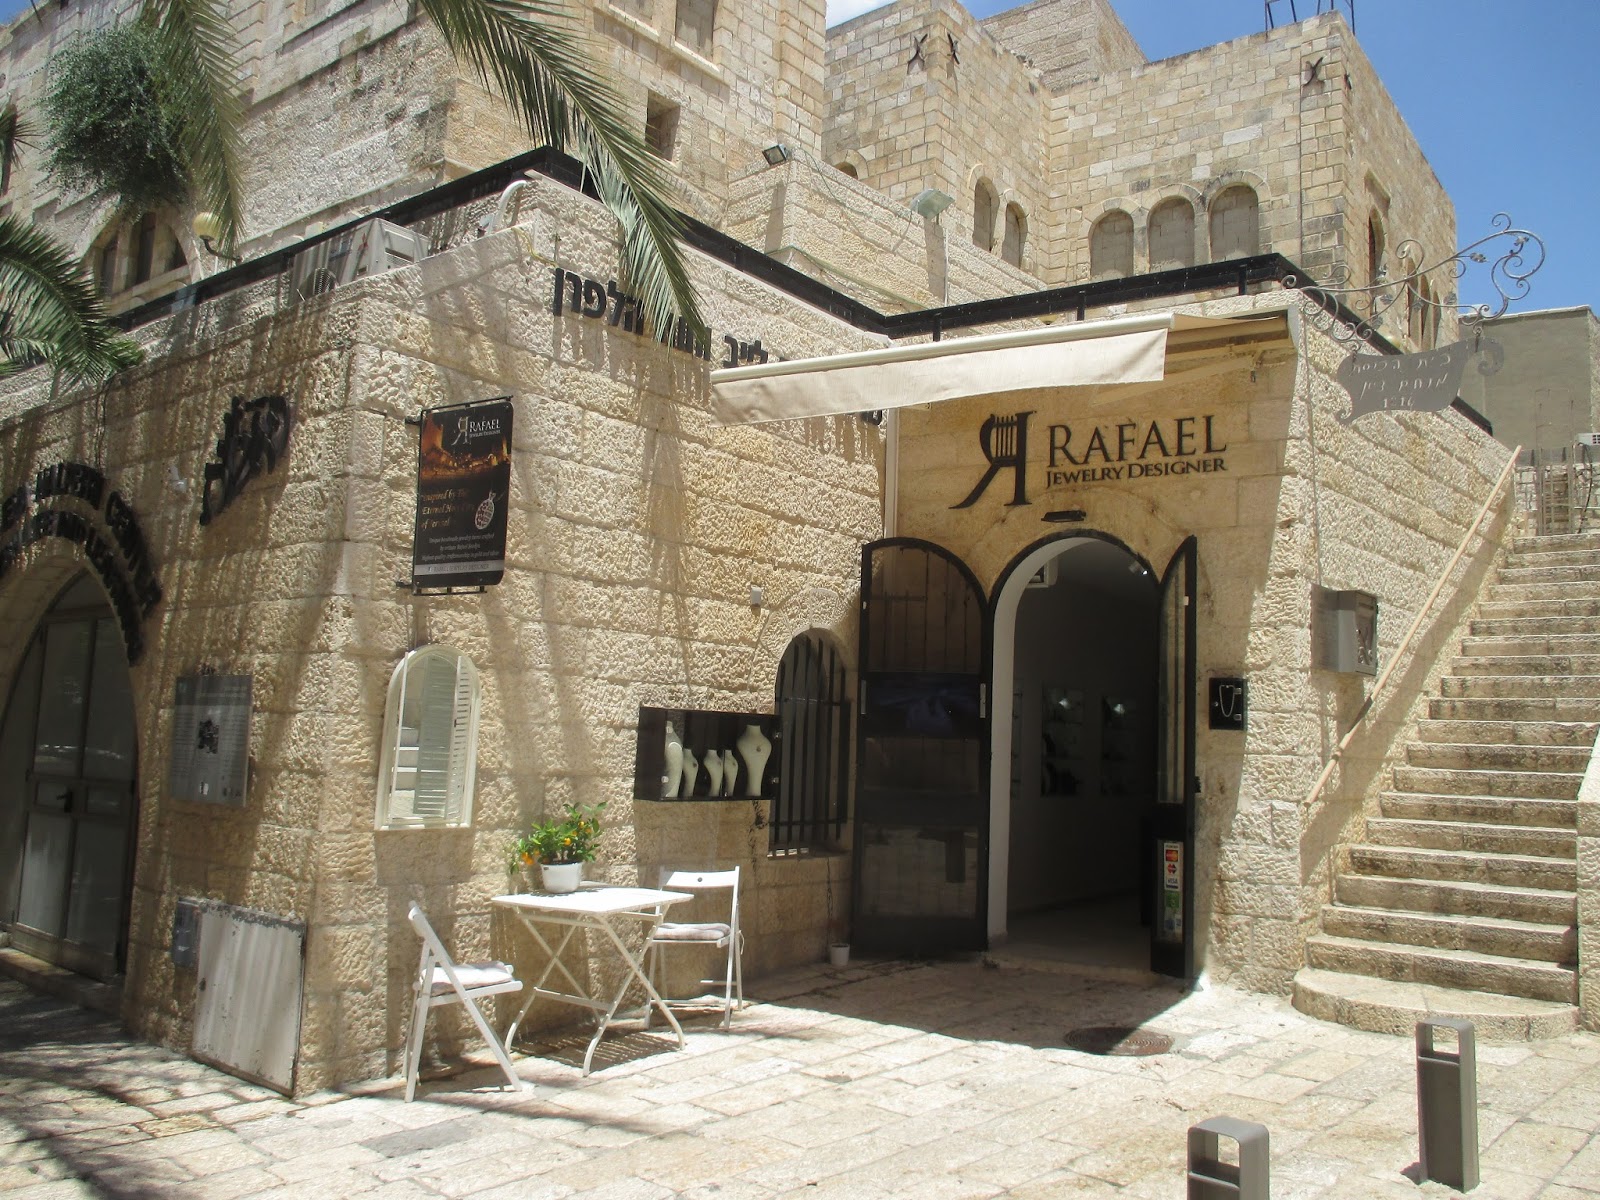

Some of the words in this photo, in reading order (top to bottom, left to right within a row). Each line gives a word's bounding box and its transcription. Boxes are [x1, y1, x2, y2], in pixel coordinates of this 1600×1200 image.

[469, 418, 501, 433] RAFAEL
[1047, 415, 1227, 467] RAFAEL
[1046, 466, 1124, 489] JEWELRY
[1126, 458, 1227, 480] DESIGNER
